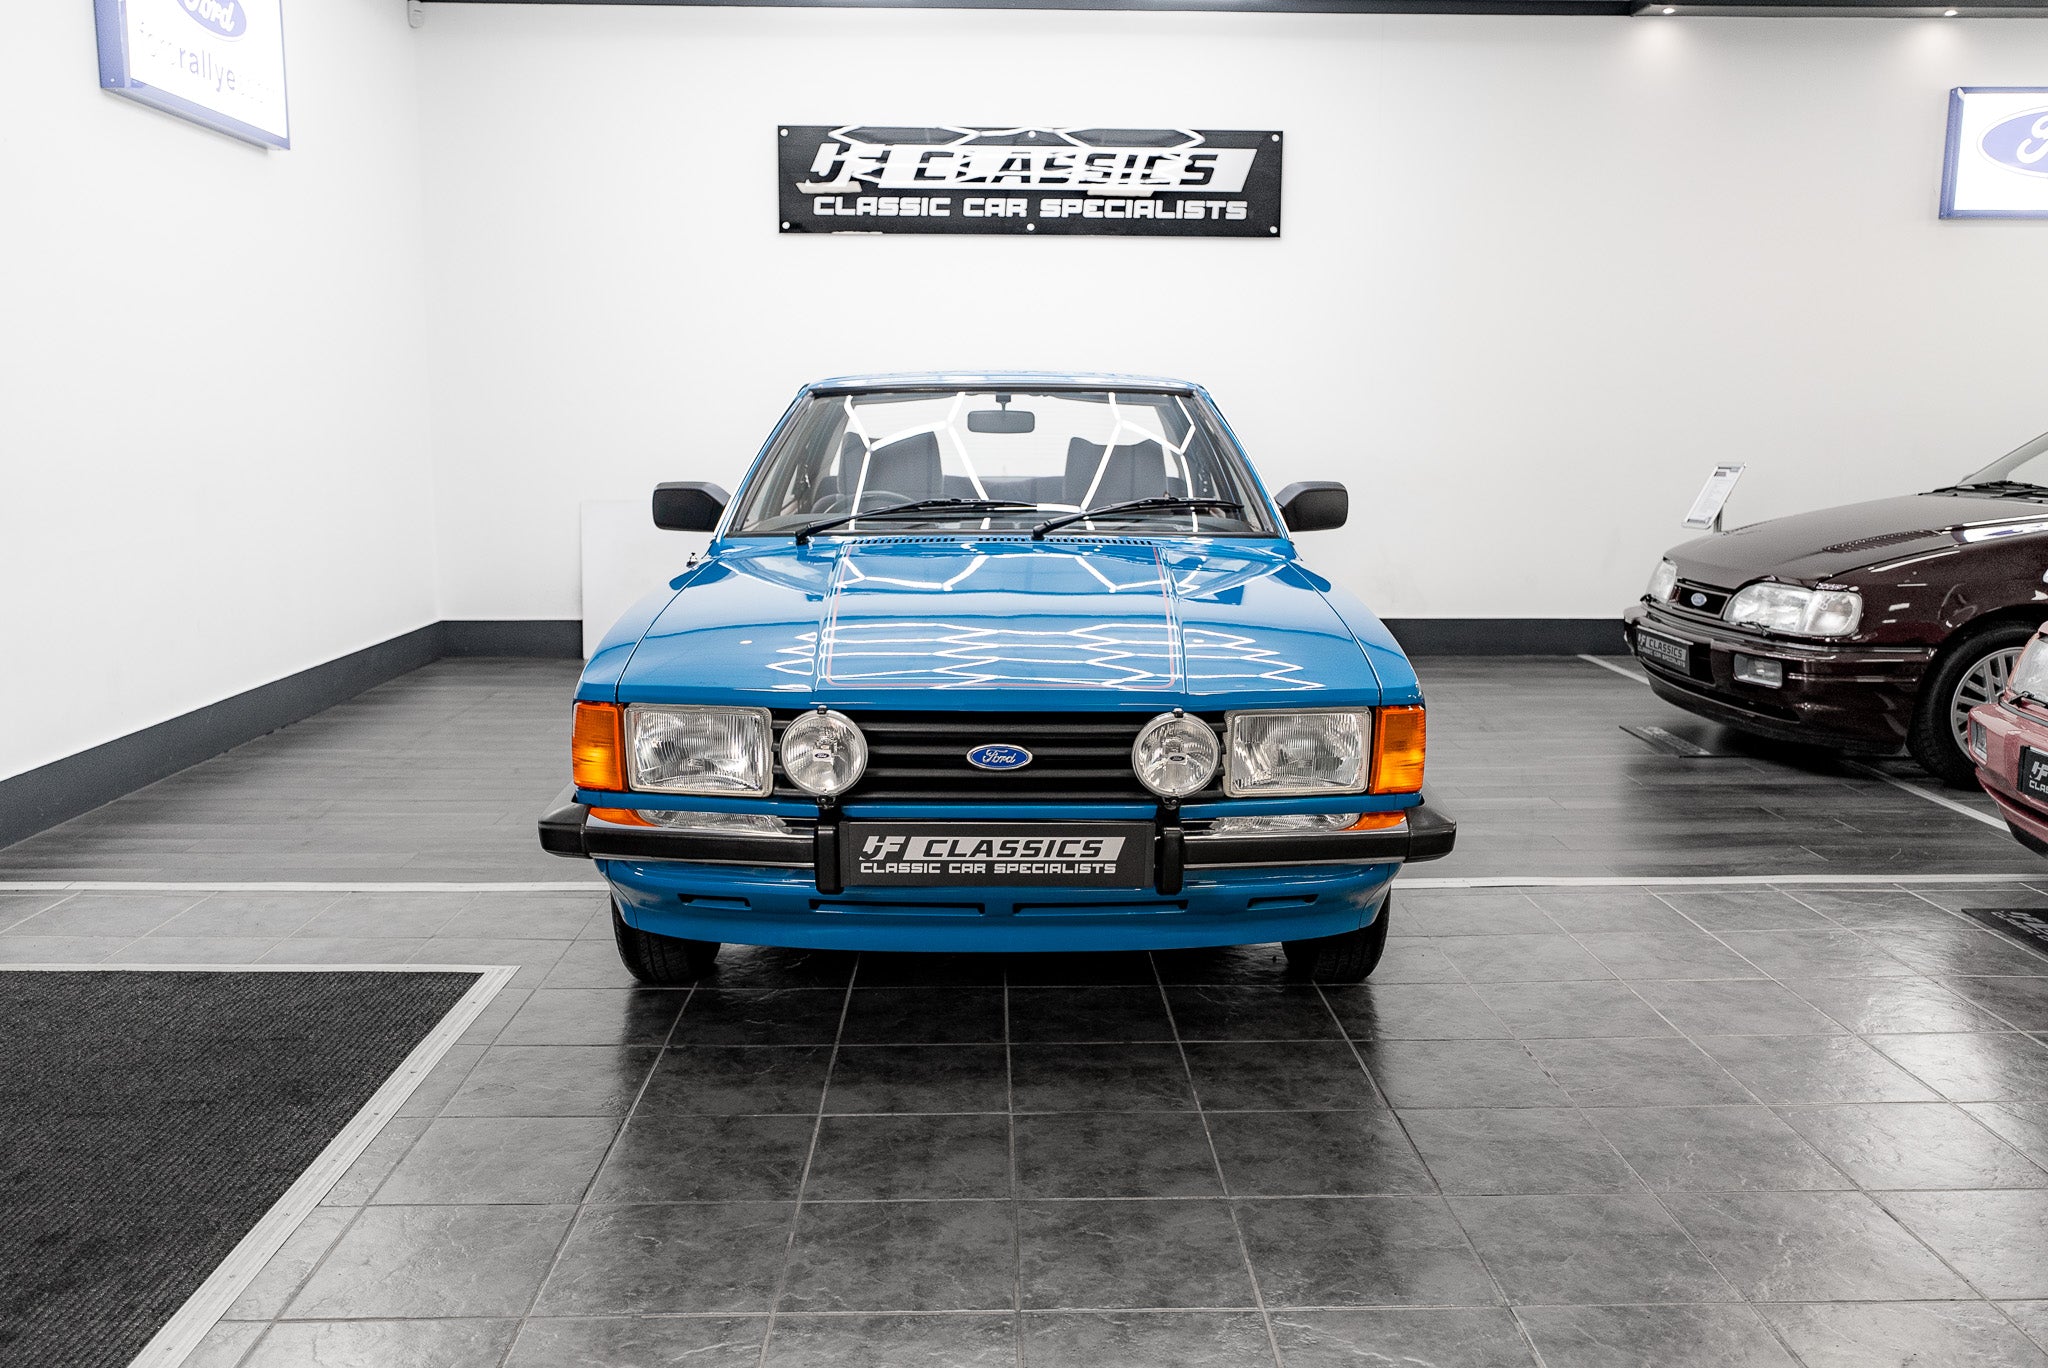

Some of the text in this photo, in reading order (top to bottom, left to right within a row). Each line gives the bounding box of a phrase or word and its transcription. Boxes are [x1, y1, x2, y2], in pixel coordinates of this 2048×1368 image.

[178, 47, 237, 93] rallye
[813, 196, 1249, 220] CLASSIC CAR SPECIALISTS
[1648, 638, 1683, 659] CLASSICS
[982, 749, 1017, 763] Ford
[922, 839, 1104, 858] CLASSICS
[860, 862, 1117, 874] CLASSIC CAR SPECIALISTS
